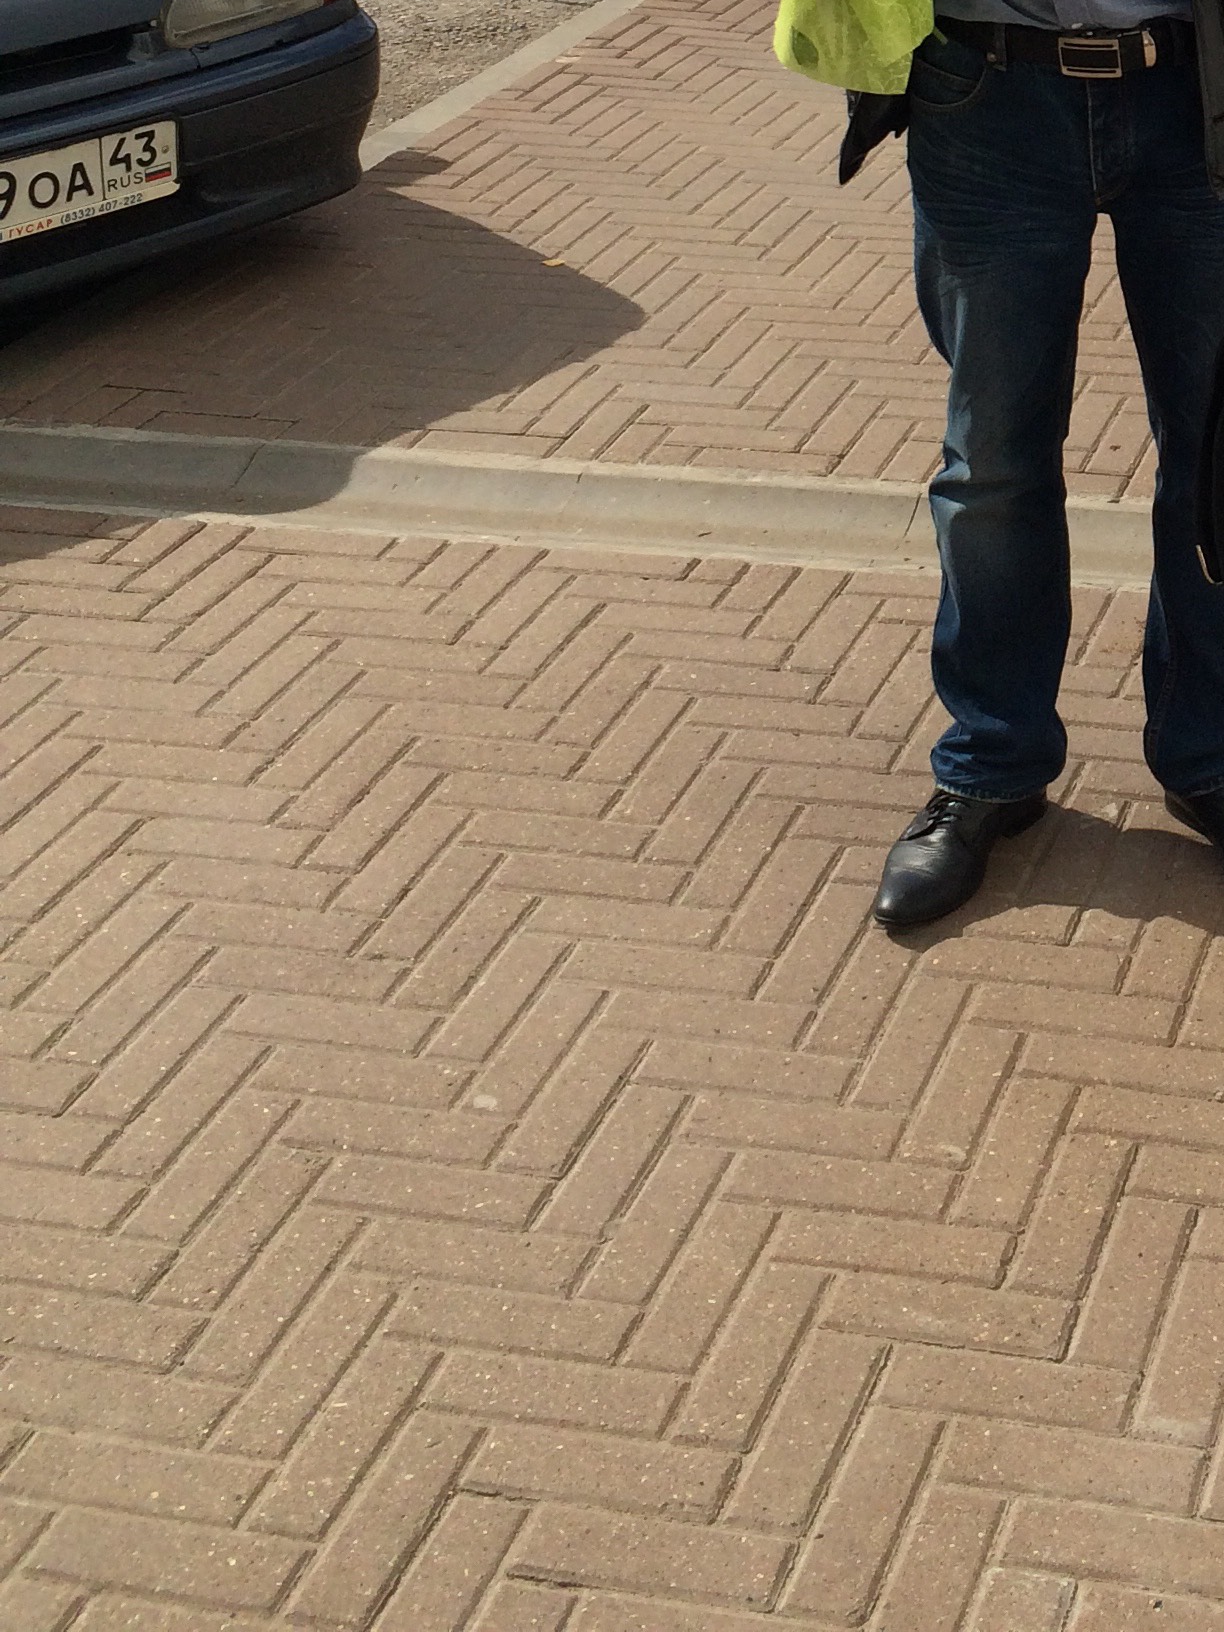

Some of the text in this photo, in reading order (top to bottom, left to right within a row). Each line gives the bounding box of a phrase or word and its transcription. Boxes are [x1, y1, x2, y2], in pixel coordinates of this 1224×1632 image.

[109, 130, 157, 173] 43
[107, 172, 143, 192] RUS
[8, 219, 53, 238] ГУСАР
[60, 208, 95, 225] (8332)
[98, 193, 143, 213] 407-222
